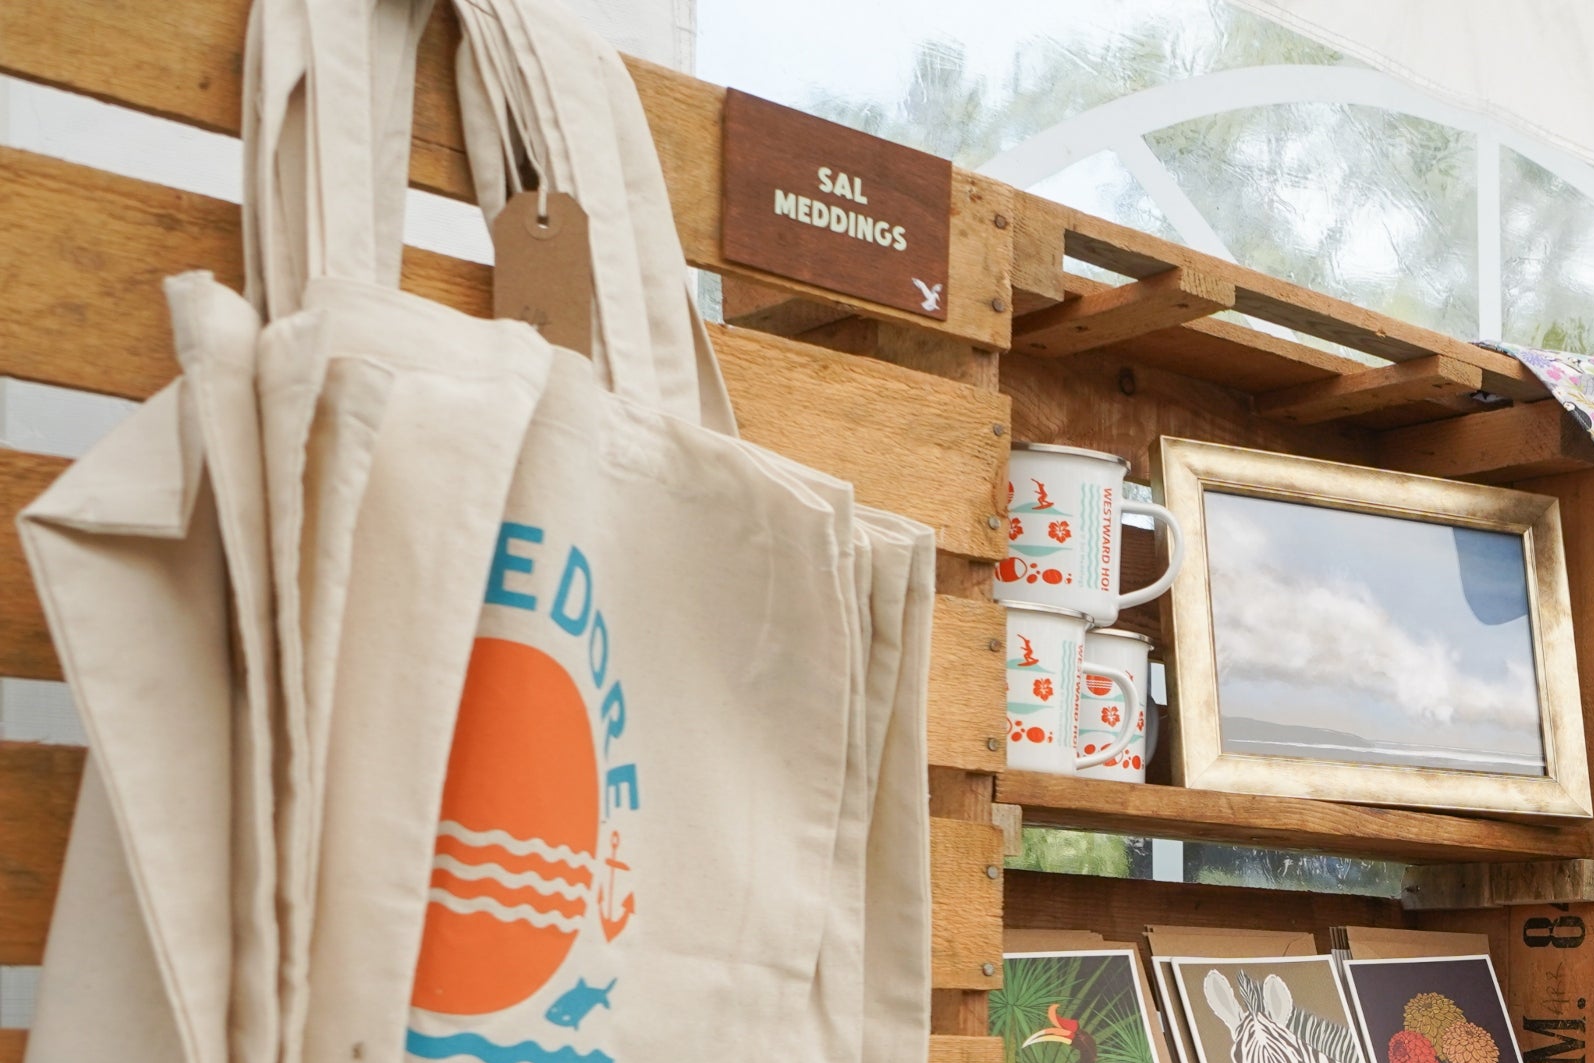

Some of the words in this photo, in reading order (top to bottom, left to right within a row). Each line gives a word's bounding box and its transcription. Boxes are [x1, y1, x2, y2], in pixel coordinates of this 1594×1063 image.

[817, 166, 868, 205] SAL
[774, 189, 907, 251] MEDDINGS
[1101, 488, 1113, 564] WESTWARD
[1100, 565, 1111, 592] HO!
